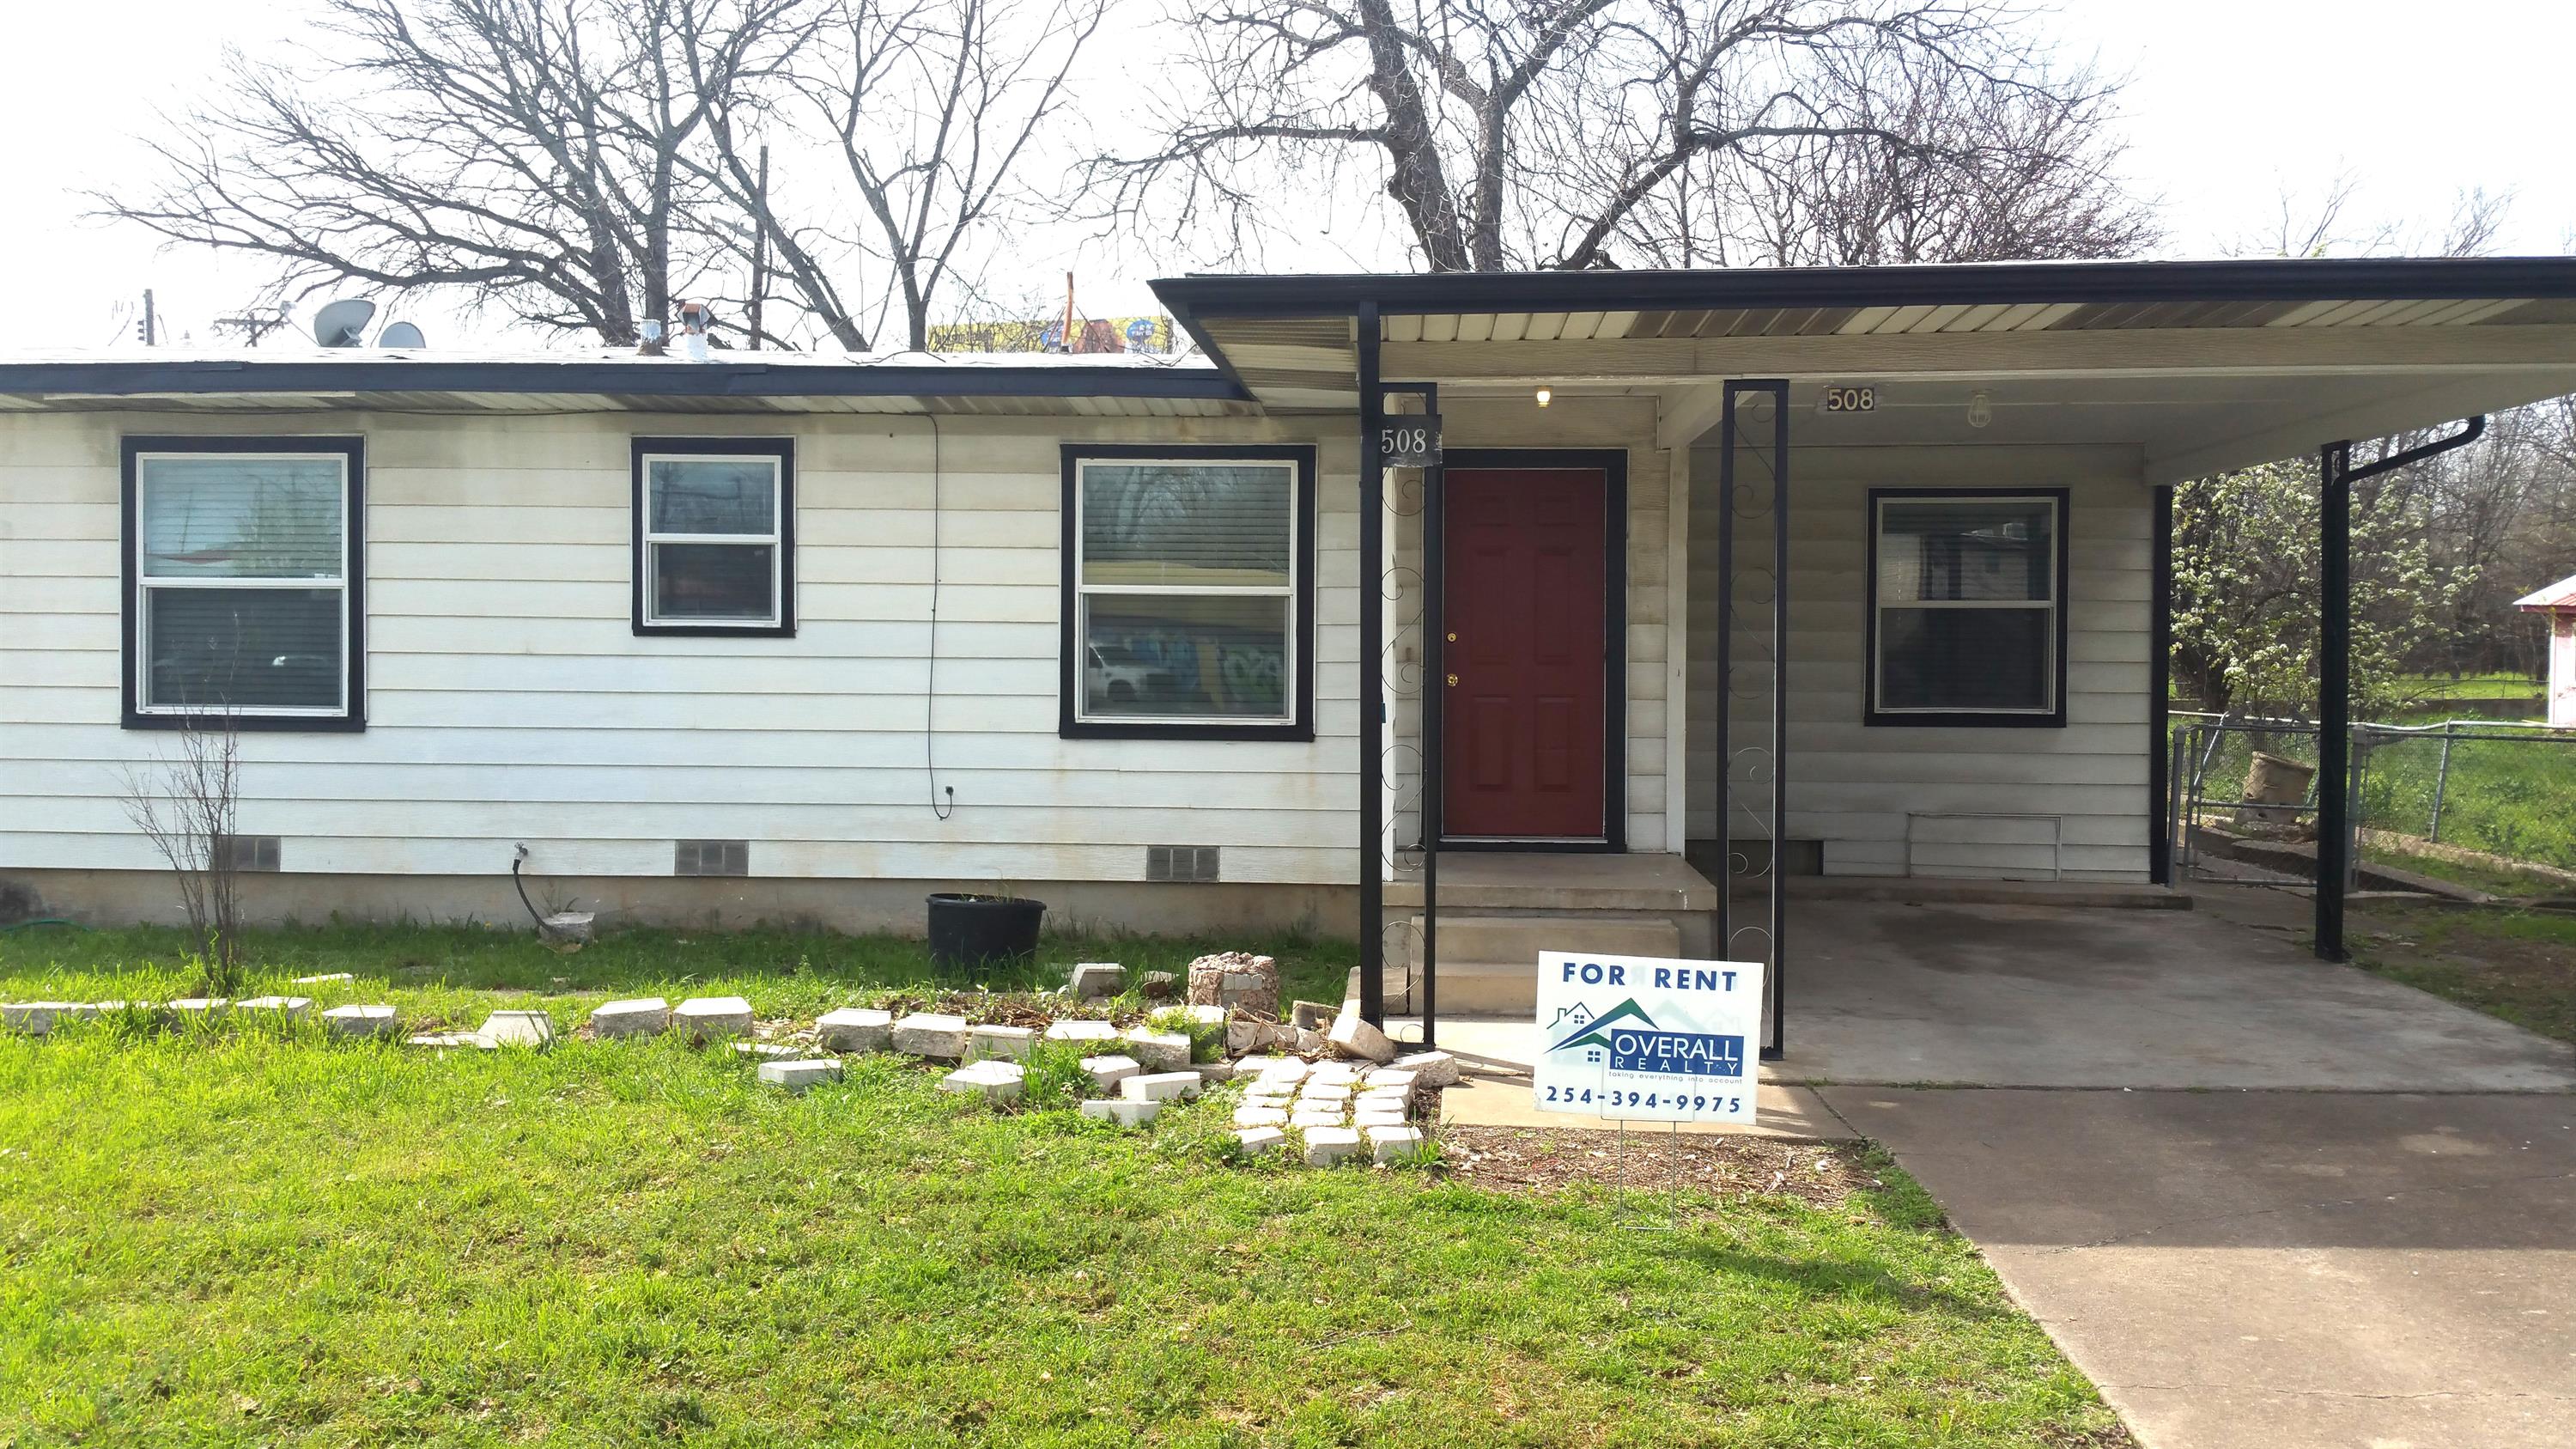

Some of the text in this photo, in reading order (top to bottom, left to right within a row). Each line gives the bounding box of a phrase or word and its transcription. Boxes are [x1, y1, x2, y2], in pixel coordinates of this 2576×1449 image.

[1828, 388, 1874, 411] 508
[1381, 429, 1426, 454] 508
[1563, 962, 1737, 992] FOR RENT
[1614, 1034, 1738, 1061] OVERALL
[1607, 1070, 1634, 1079] taking
[1638, 1073, 1684, 1082] everything
[1614, 1056, 1738, 1075] REALTY
[1546, 1086, 1741, 1113] 254-394-9975
